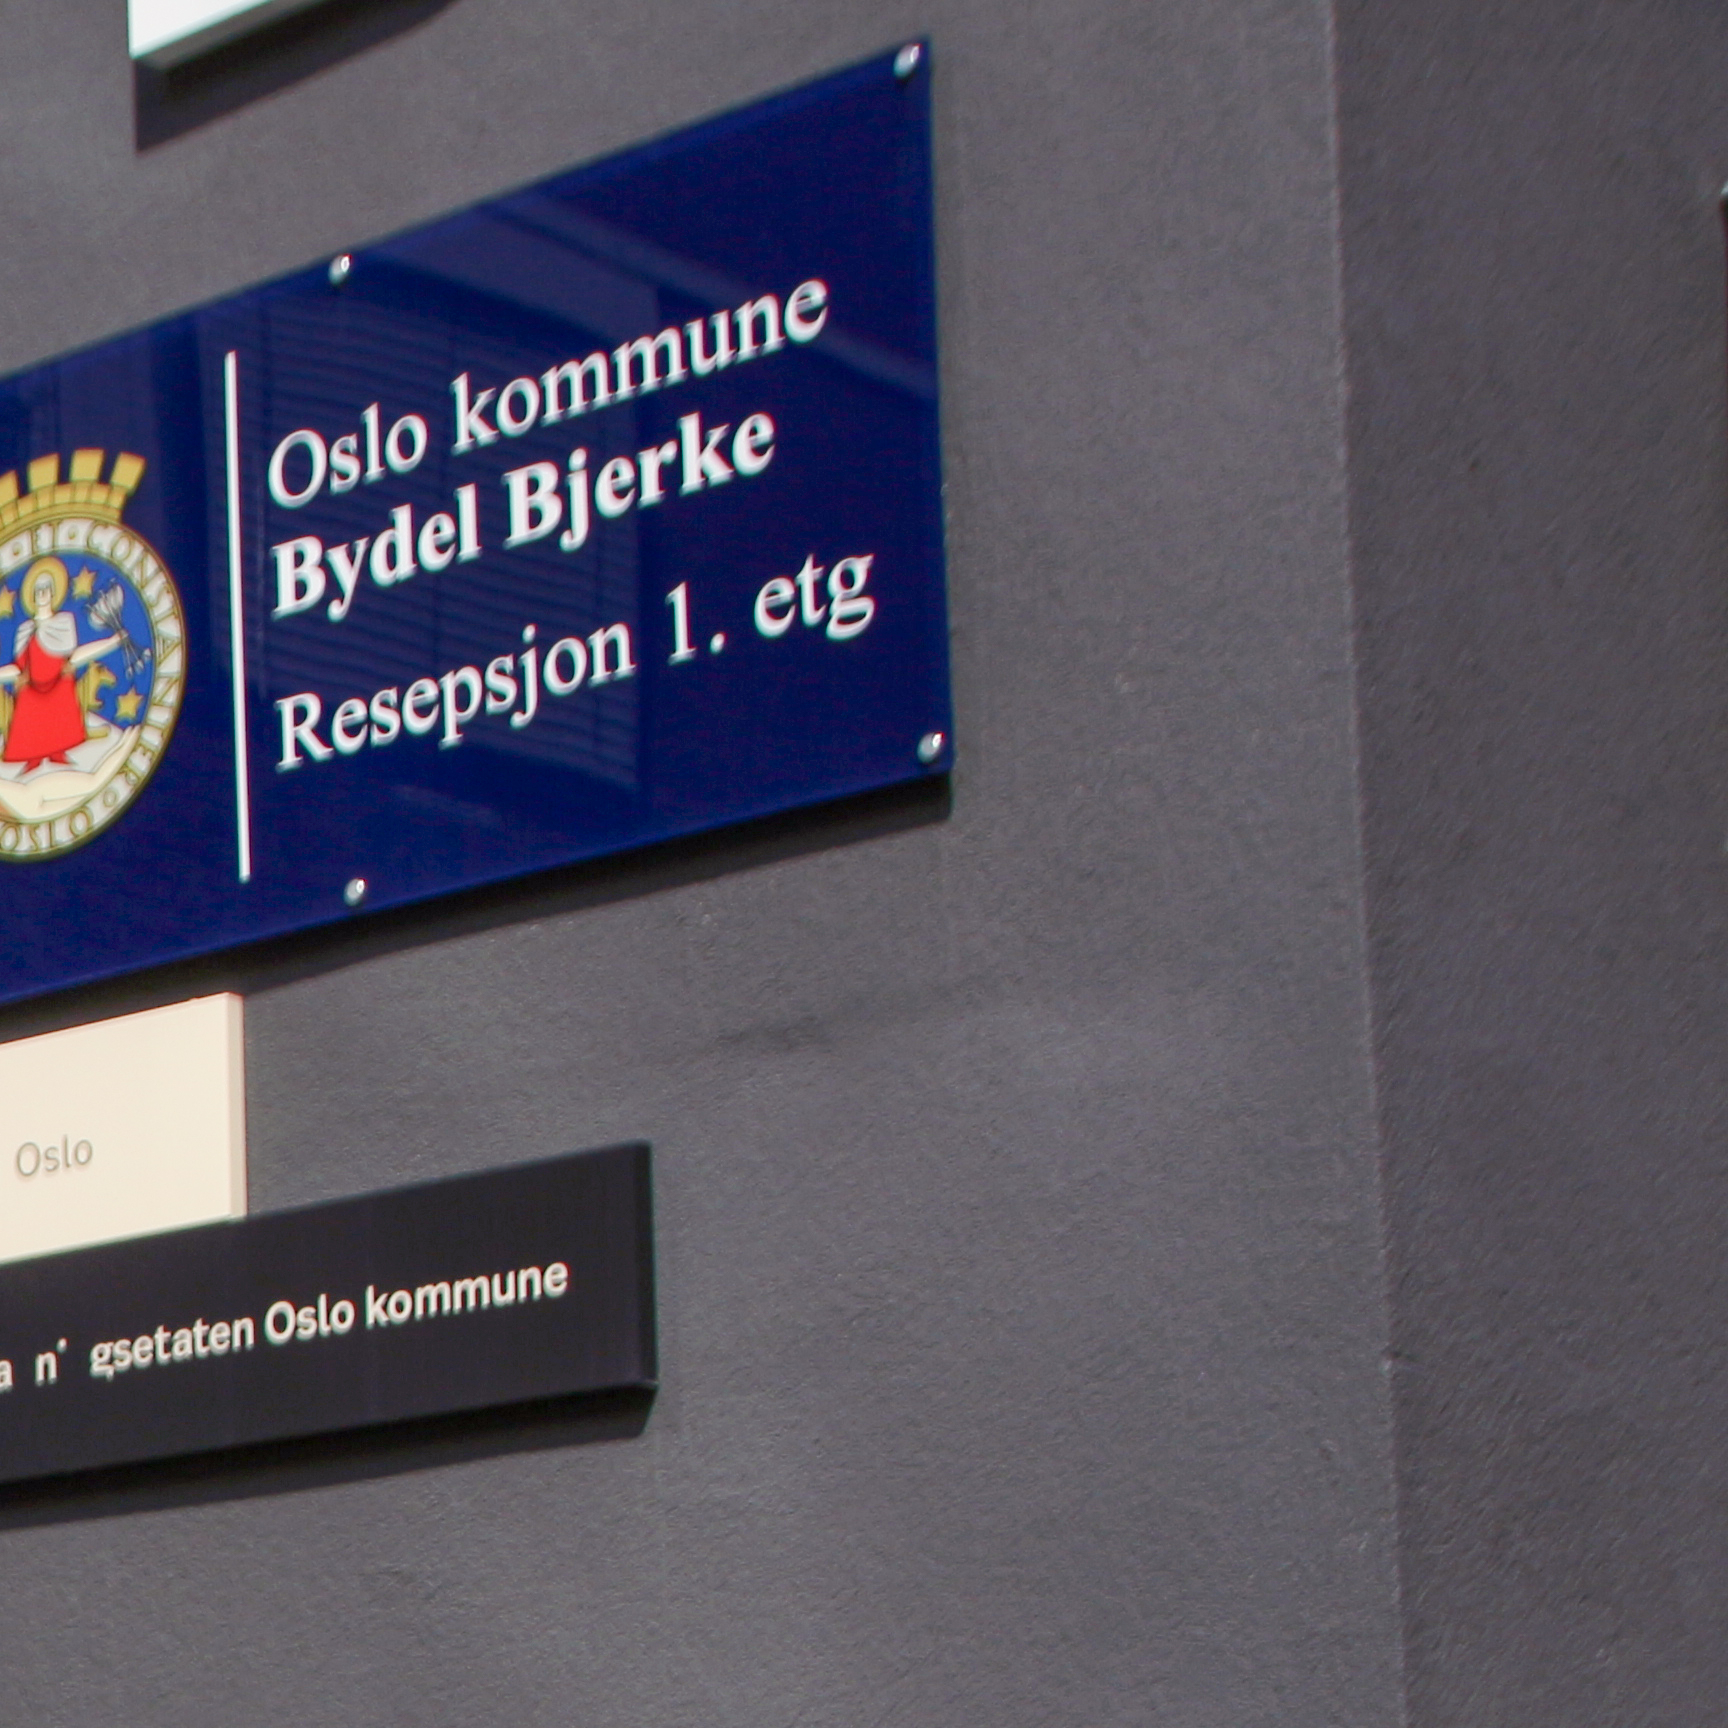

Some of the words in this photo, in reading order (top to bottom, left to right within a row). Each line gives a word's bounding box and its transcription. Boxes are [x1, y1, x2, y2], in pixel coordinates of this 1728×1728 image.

[270, 405, 426, 505] Oslo
[453, 282, 825, 450] kommune
[273, 485, 480, 614] Bydel
[505, 415, 773, 544] Bjerke
[277, 624, 634, 768] Resepsjon
[669, 584, 723, 659] 1.
[756, 556, 873, 637] etg
[16, 1133, 93, 1178] Oslo
[90, 1314, 255, 1381] gsetaten
[264, 1294, 355, 1346] Oslo
[365, 1261, 570, 1329] kommune
